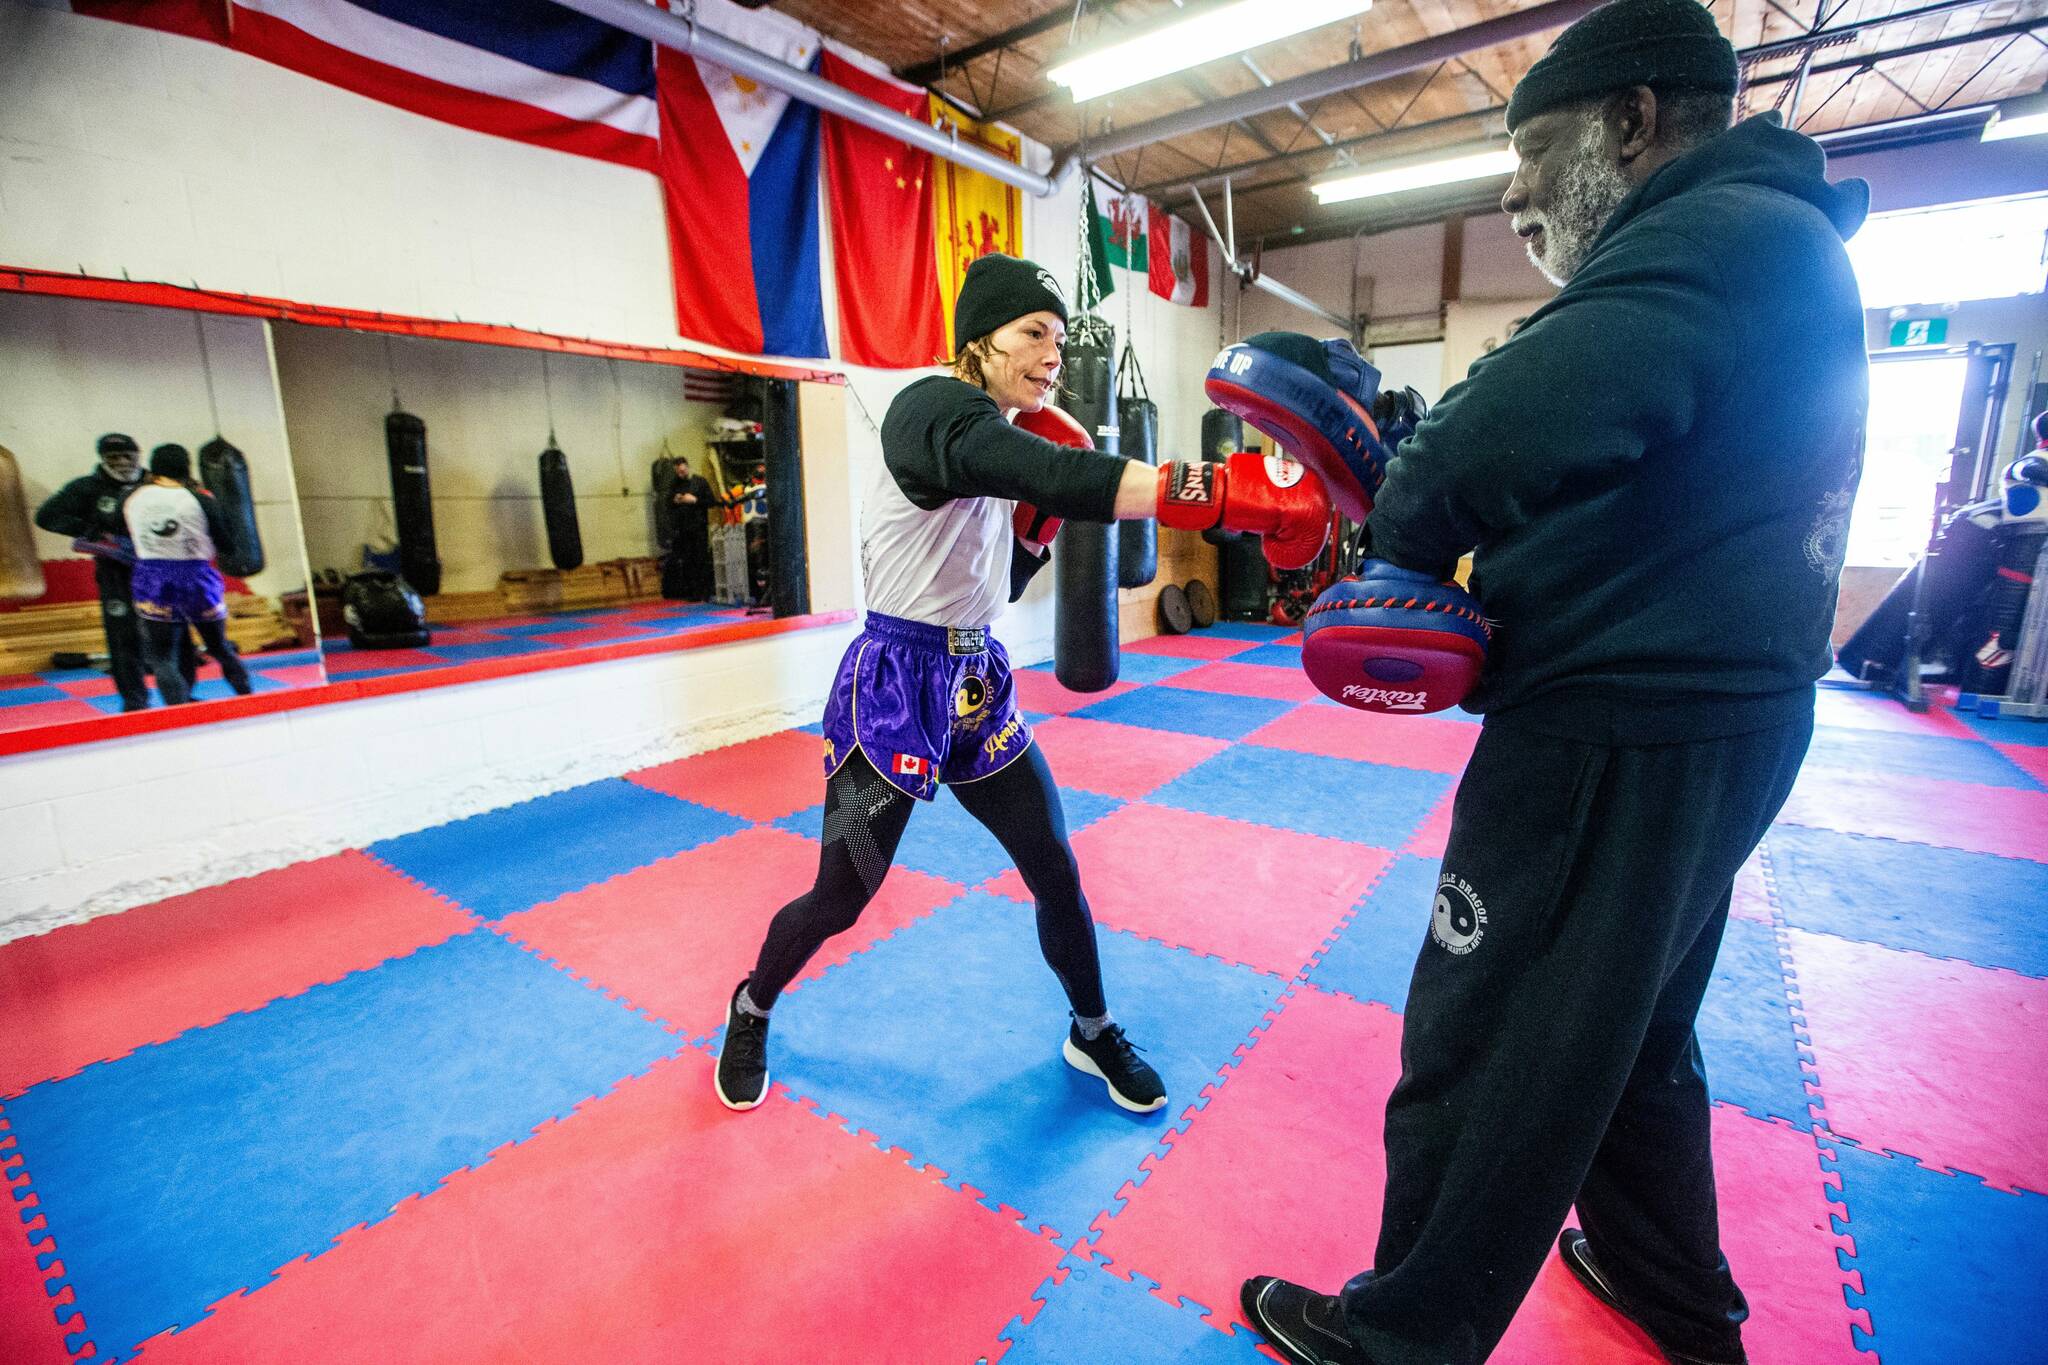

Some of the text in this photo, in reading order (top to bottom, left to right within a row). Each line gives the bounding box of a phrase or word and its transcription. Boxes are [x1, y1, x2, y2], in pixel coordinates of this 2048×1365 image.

[1229, 352, 1253, 376] UP
[1342, 684, 1427, 710] Fairtex
[1458, 878, 1488, 925] DRAGON
